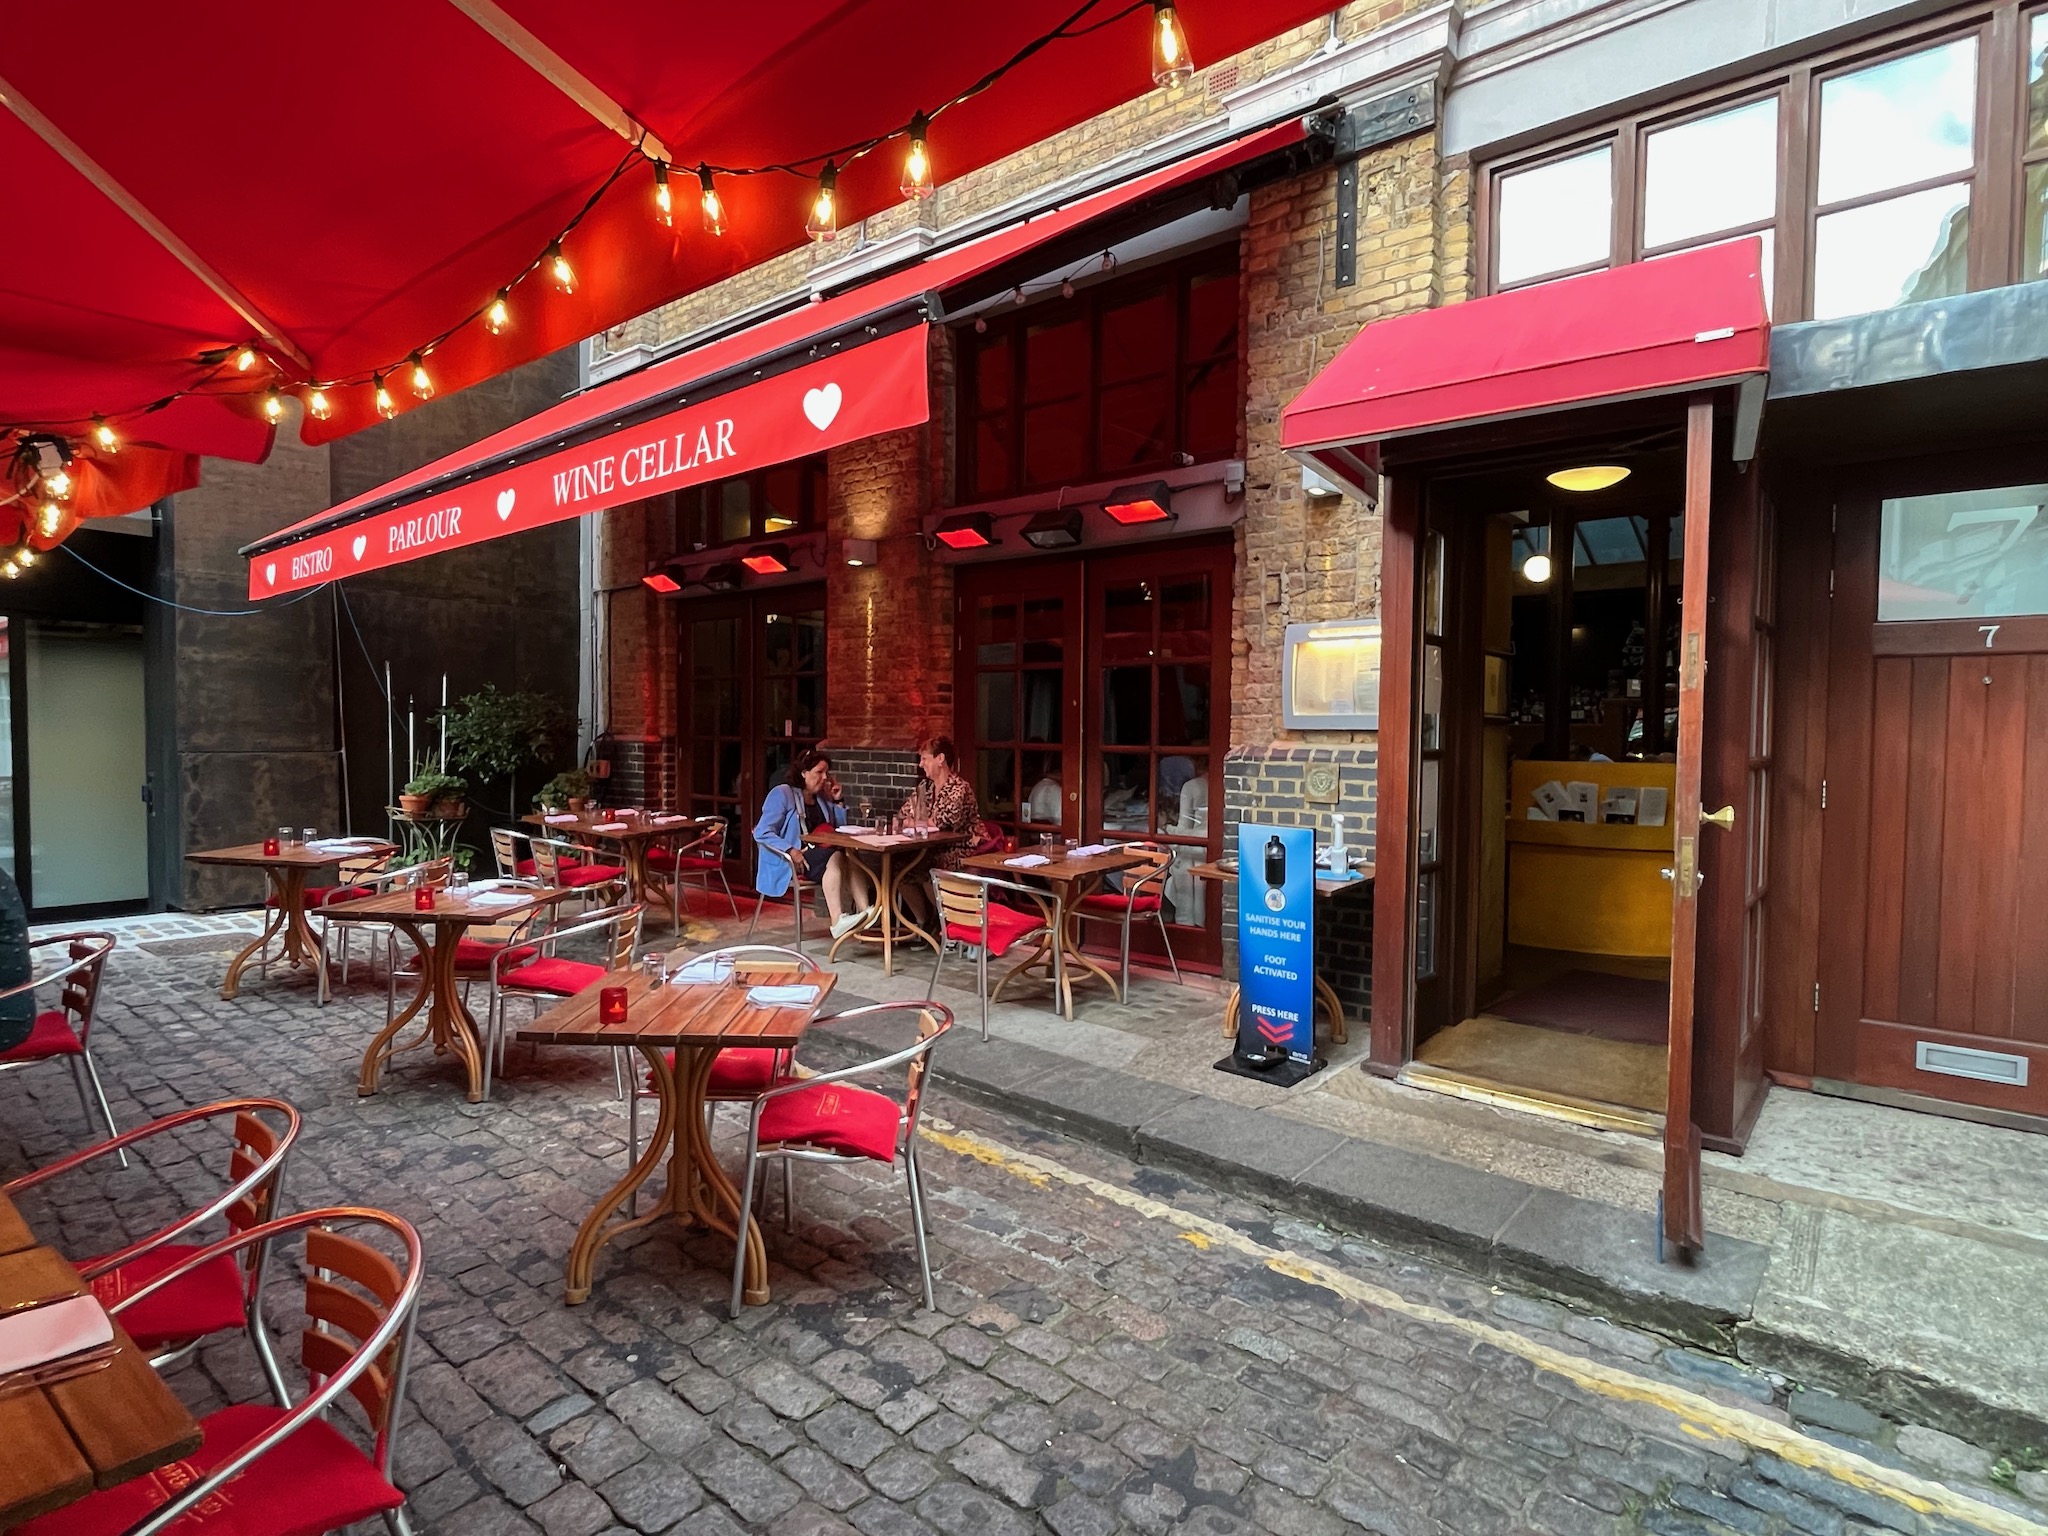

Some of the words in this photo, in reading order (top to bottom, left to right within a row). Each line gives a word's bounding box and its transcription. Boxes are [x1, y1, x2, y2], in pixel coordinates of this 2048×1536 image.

[291, 546, 333, 581] BISTRO
[388, 506, 462, 554] PARLOUR
[552, 455, 615, 507] WINE
[620, 418, 737, 487] CELLAR
[1978, 625, 2001, 648] 7
[1245, 912, 1281, 926] SANITISE
[1282, 918, 1307, 931] YOUR
[1249, 926, 1279, 939] HANDS
[1280, 931, 1302, 943] HERE
[1264, 954, 1287, 966] FOOT
[1253, 965, 1298, 981] ACTIVATED
[1251, 1003, 1276, 1018] PRESS
[1277, 1009, 1299, 1023] HERE
